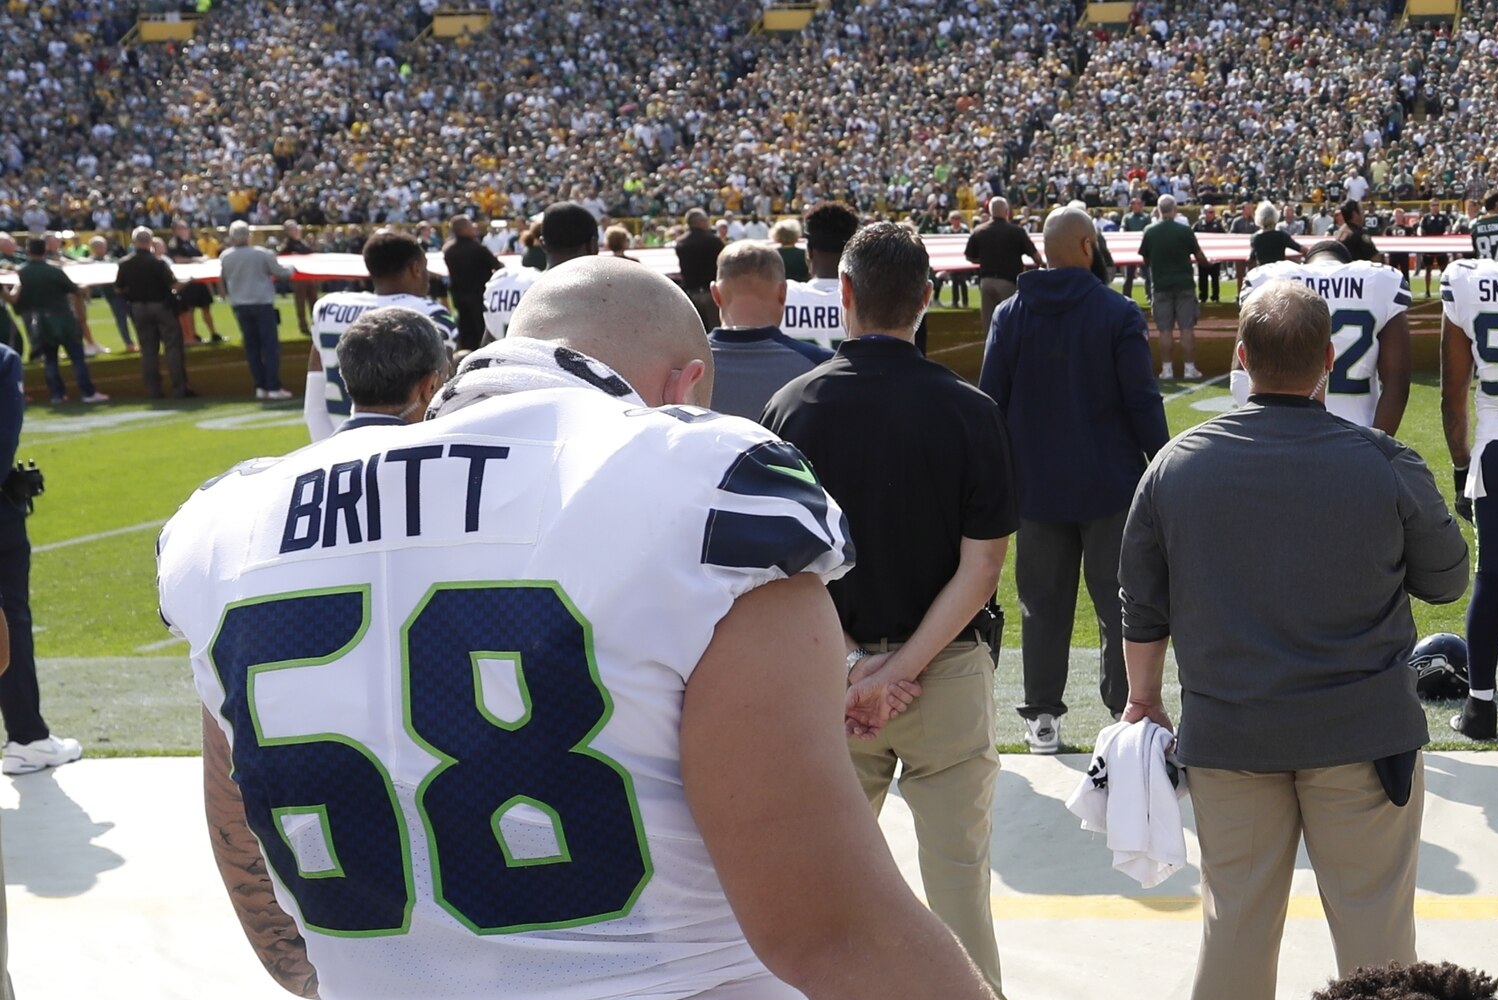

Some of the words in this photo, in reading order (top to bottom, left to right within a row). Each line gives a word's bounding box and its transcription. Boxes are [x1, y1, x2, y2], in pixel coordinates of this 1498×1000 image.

[1365, 217, 1378, 228] 20
[1291, 276, 1364, 299] ARVIN
[489, 289, 528, 313] CHA
[785, 305, 839, 328] DARB
[278, 444, 510, 555] BRITT
[207, 579, 655, 939] 68
